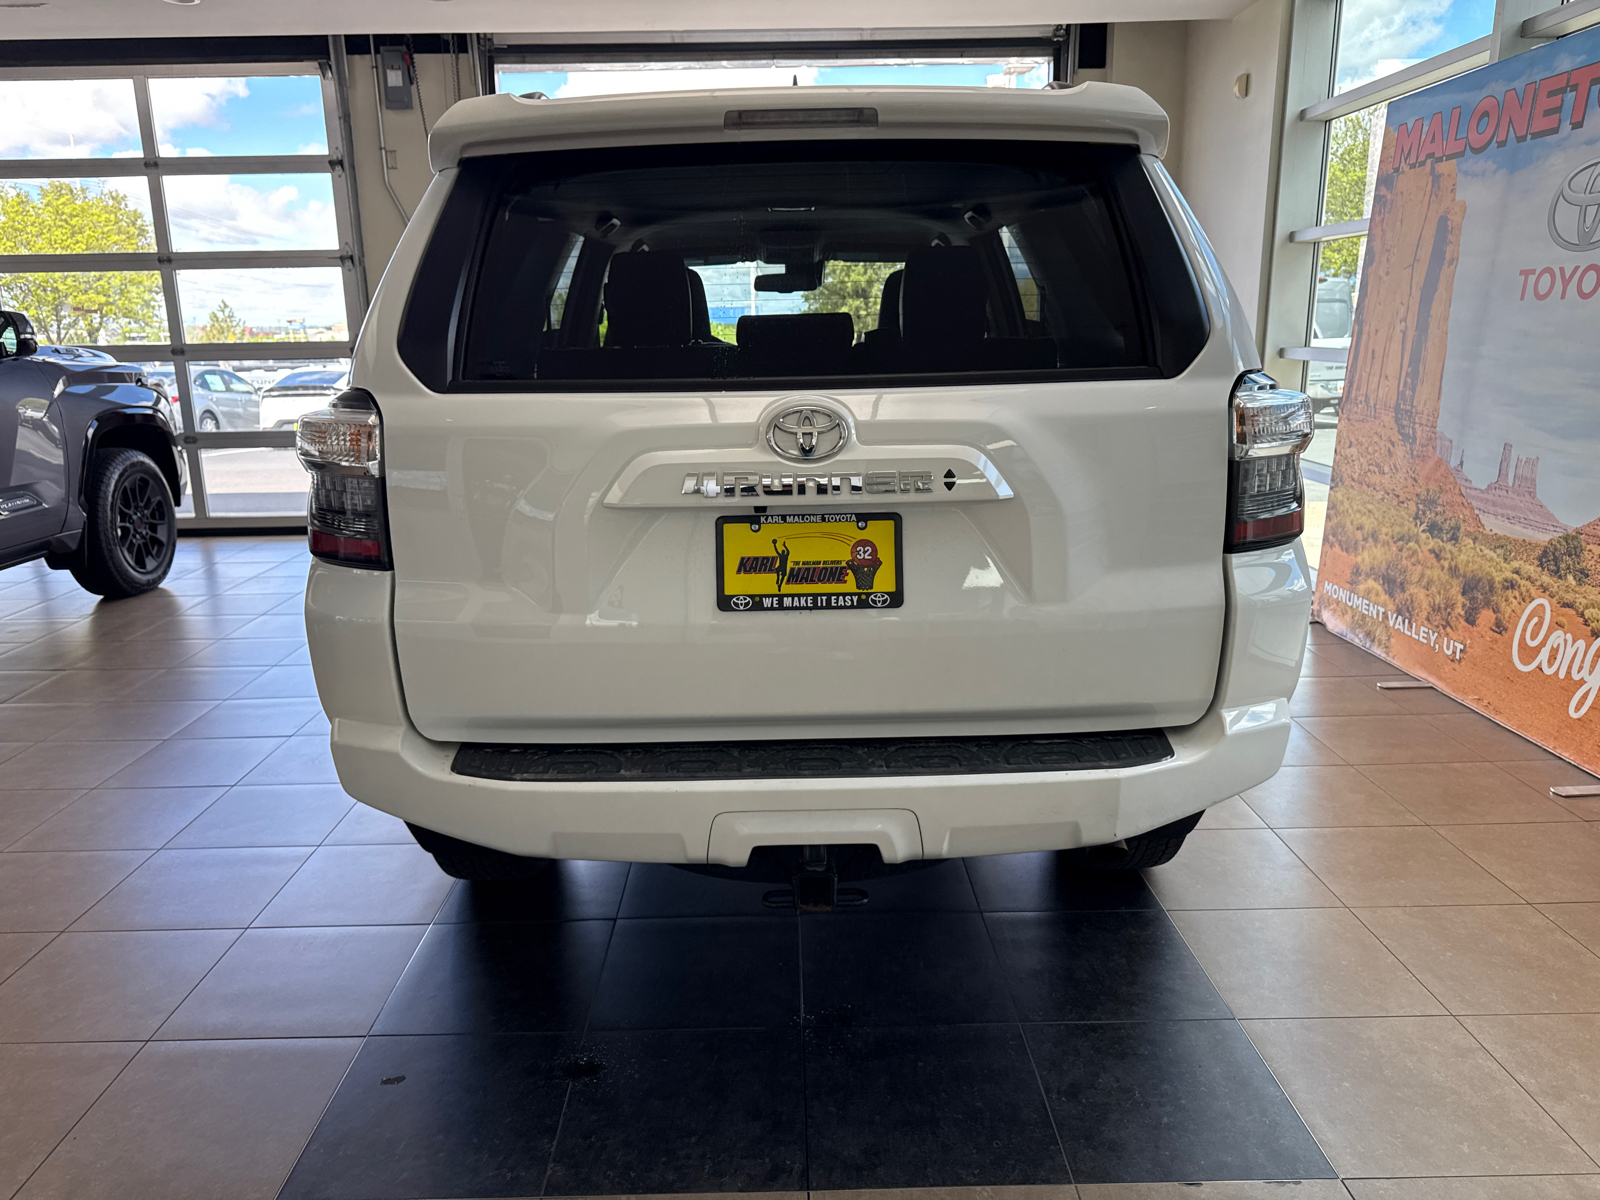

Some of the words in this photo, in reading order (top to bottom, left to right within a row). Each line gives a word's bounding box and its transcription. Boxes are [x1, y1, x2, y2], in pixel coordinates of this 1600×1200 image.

[1392, 60, 1600, 173] MALONET
[682, 470, 934, 498] 4RUNNER
[760, 515, 785, 524] KARL
[786, 514, 823, 524] MALONE
[824, 513, 858, 523] TOYOTA
[856, 546, 873, 560] 32
[736, 556, 779, 575] KARL
[785, 566, 849, 585] MALONE
[762, 597, 779, 608] WE
[783, 596, 814, 607] MAKE
[817, 595, 828, 606] IT
[831, 595, 859, 606] EASY
[1323, 580, 1386, 622] MONUMENT
[1387, 610, 1440, 652] VALLEY,
[1443, 636, 1465, 660] UT
